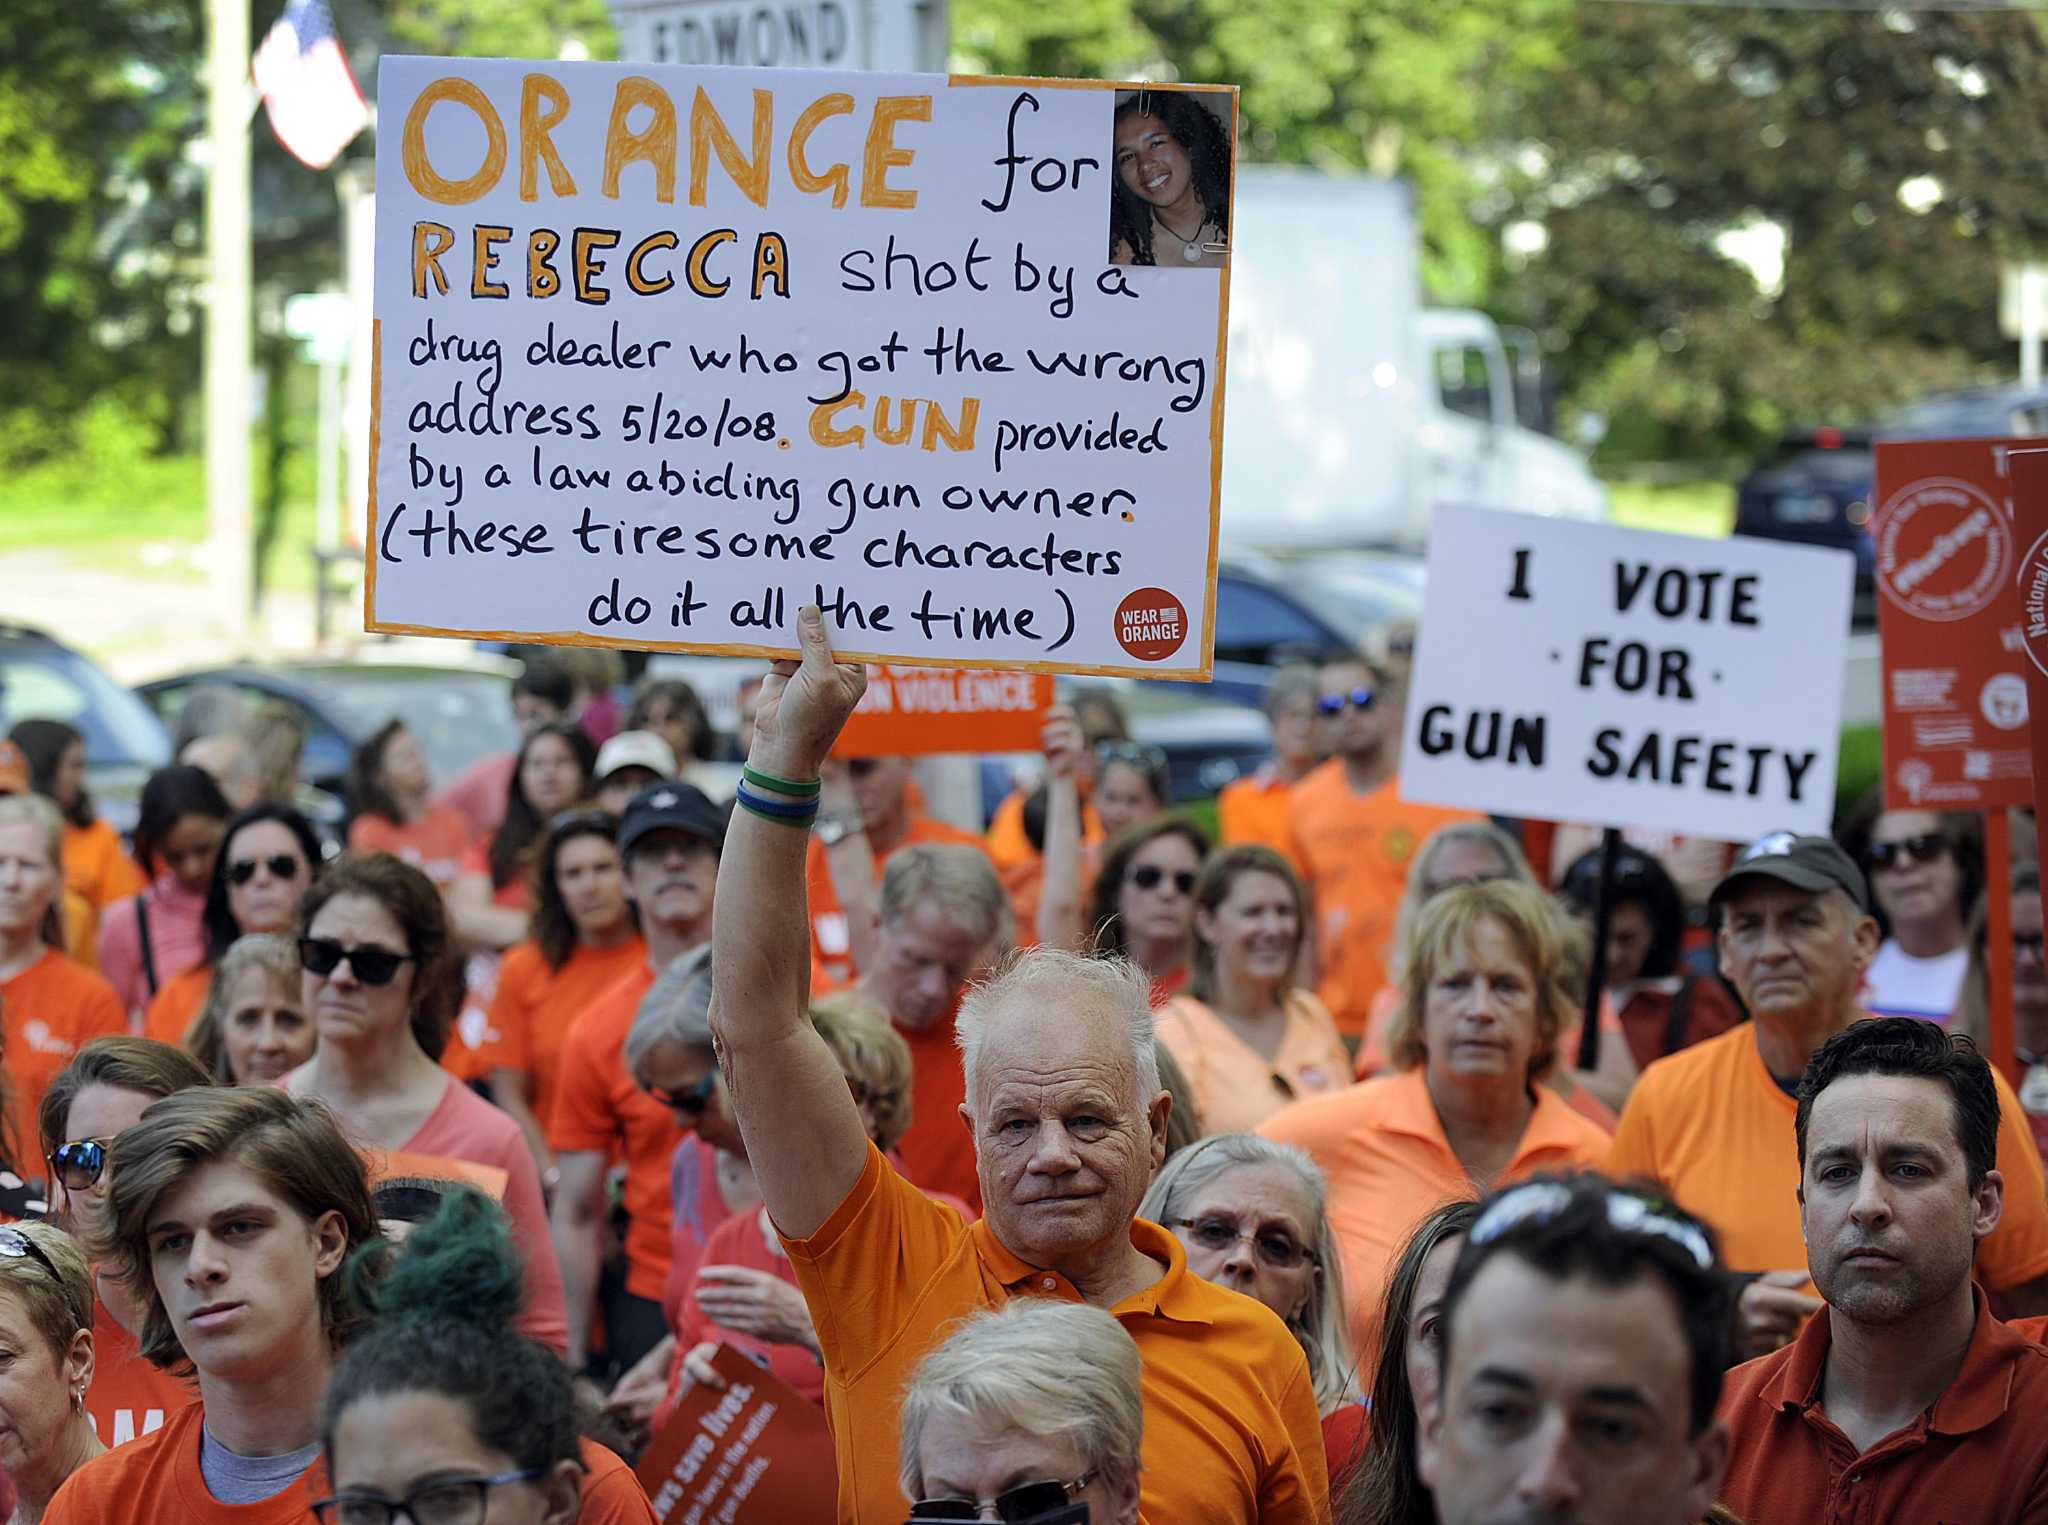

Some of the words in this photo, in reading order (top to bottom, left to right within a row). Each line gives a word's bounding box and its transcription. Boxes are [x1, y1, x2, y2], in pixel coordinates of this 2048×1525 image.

[402, 73, 932, 208] ORANGE
[981, 92, 1099, 212] for
[412, 221, 790, 305] REBECCA
[840, 235, 992, 296] shot
[1014, 242, 1073, 318] by
[1096, 268, 1139, 298] a
[408, 318, 501, 395] drug
[526, 322, 671, 369] dealer
[689, 334, 798, 374] who
[808, 332, 908, 405] got
[924, 327, 1015, 376] the
[1027, 350, 1206, 413] wrong
[408, 381, 601, 440] address
[808, 390, 981, 453] GUN
[994, 411, 1169, 472] provided
[409, 442, 464, 506] by
[484, 463, 512, 488] a
[533, 445, 611, 488] law
[626, 460, 801, 525] abiding
[826, 477, 921, 535] gun
[942, 484, 1137, 524] owner.
[380, 503, 555, 563] (these
[572, 507, 836, 561] tiresome
[863, 529, 1123, 577] characters
[588, 578, 652, 627] do
[670, 580, 708, 628] it
[729, 586, 785, 629] all
[799, 583, 895, 631] the
[910, 589, 1075, 653] time)
[1121, 608, 1157, 625] WEAR
[1507, 549, 1531, 600] I
[1615, 561, 1760, 626] VOTE
[2027, 561, 2048, 639] National
[1122, 623, 1180, 643] ORANGE
[1578, 638, 1694, 700] FOR
[898, 675, 1035, 713] VIOLENCE
[1419, 705, 1546, 767] GUN
[1586, 728, 1816, 801] SAFETY
[673, 1432, 716, 1484] save
